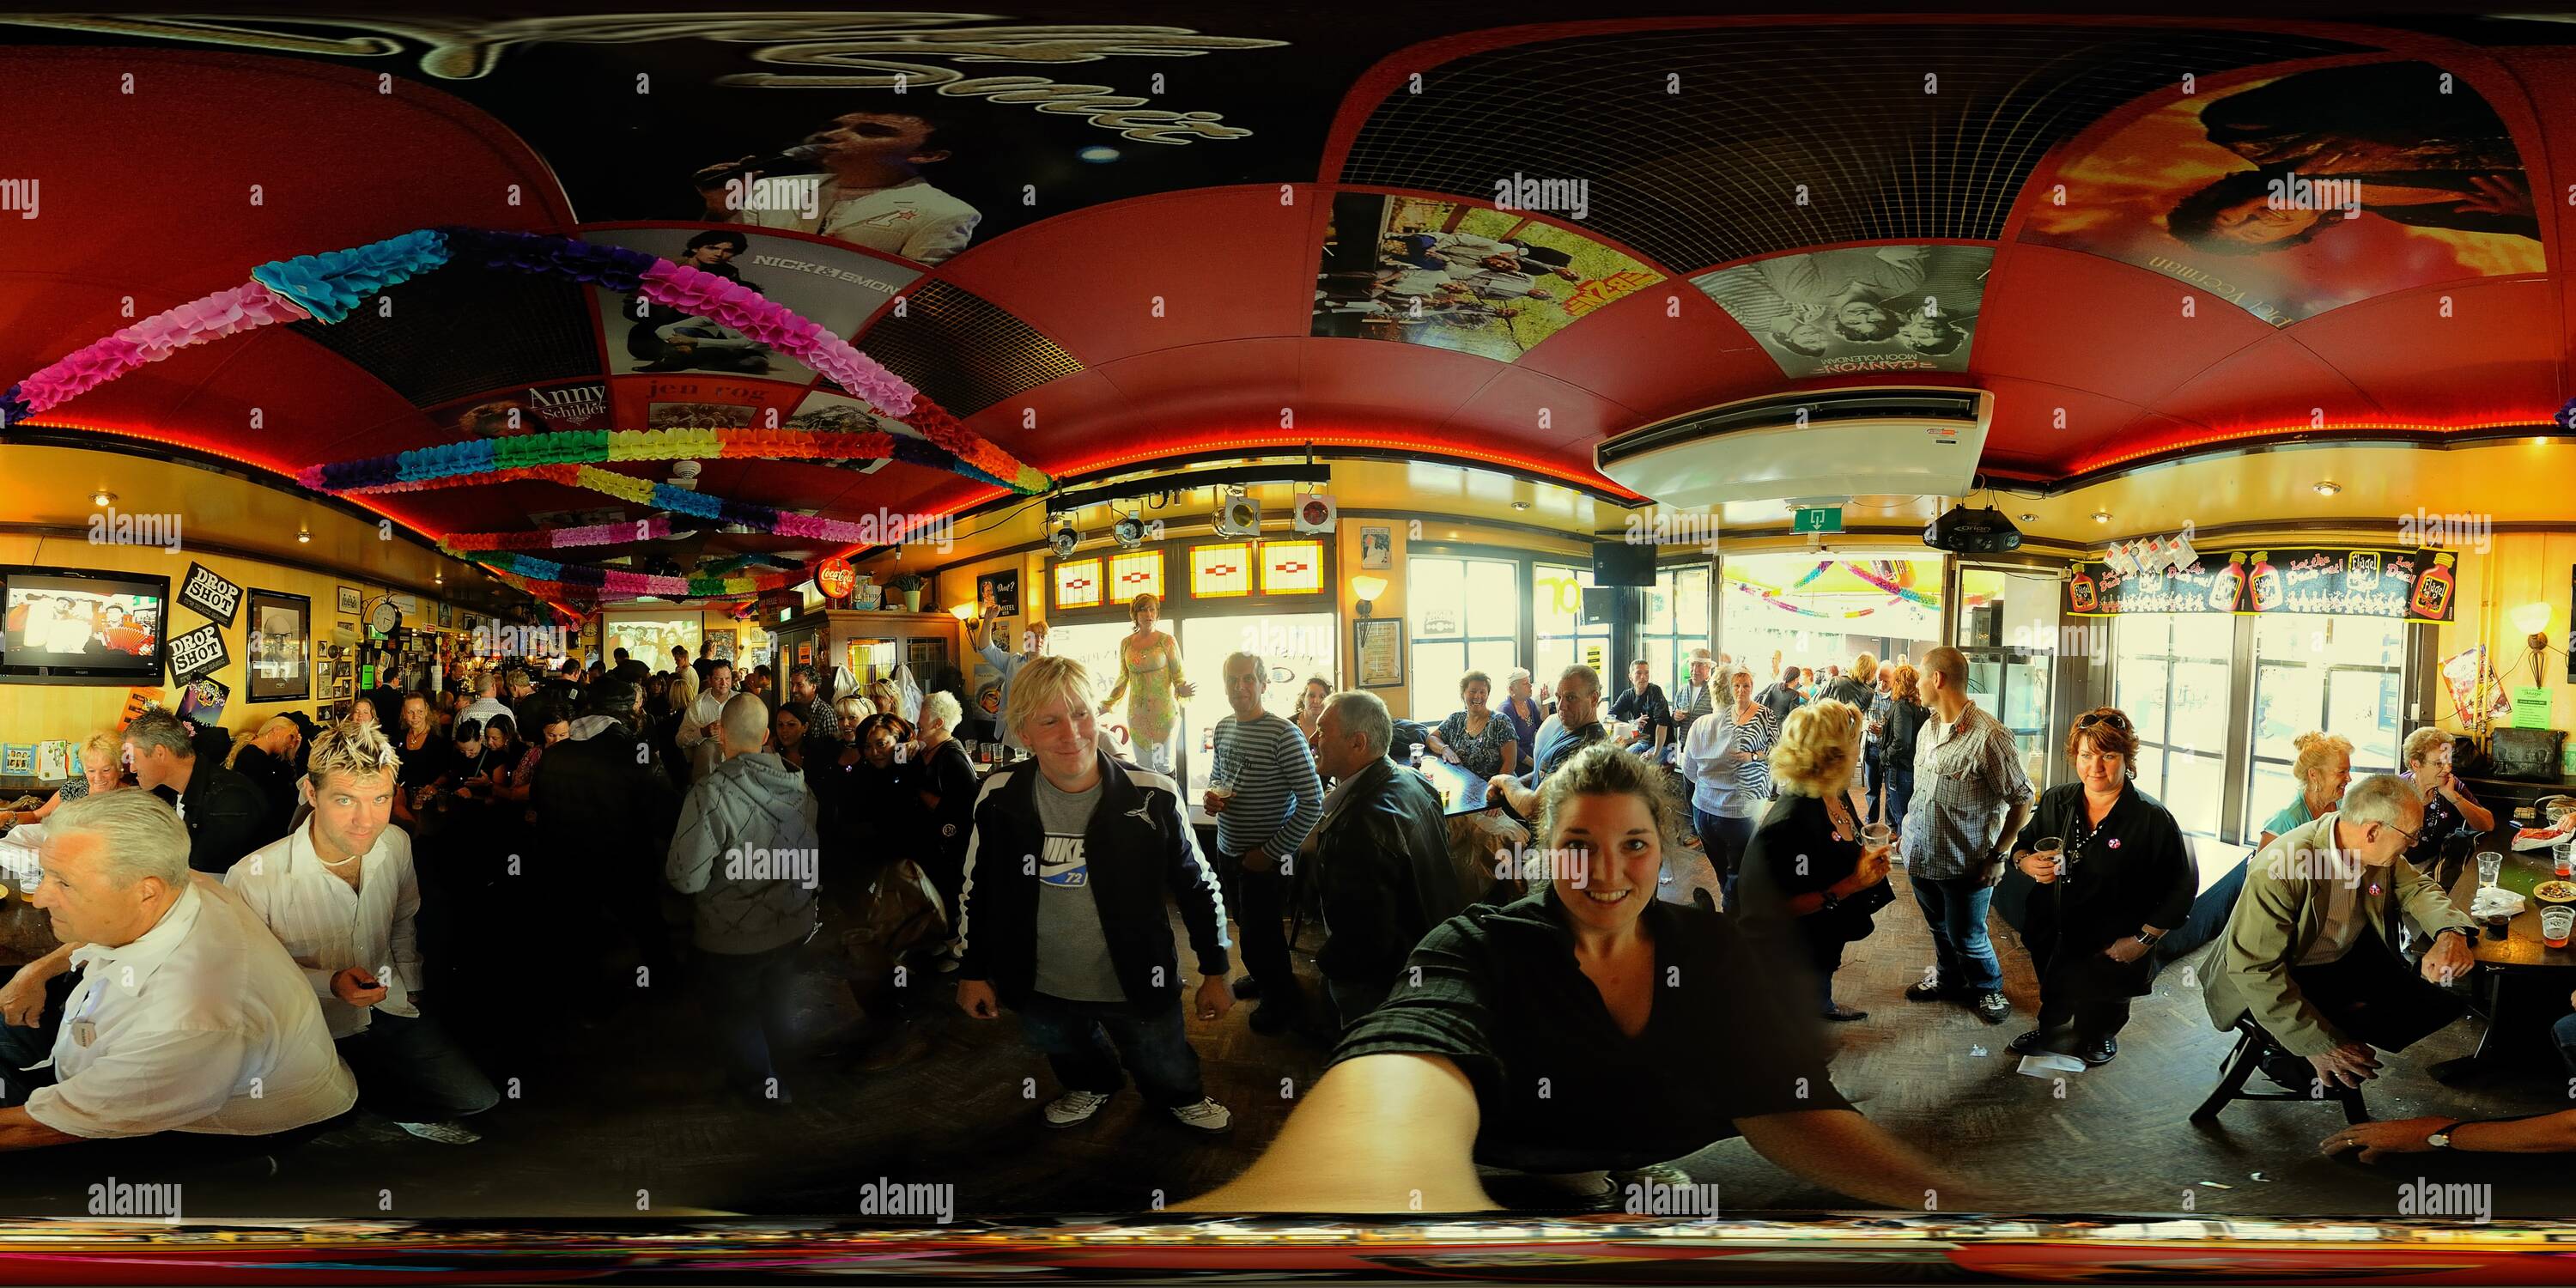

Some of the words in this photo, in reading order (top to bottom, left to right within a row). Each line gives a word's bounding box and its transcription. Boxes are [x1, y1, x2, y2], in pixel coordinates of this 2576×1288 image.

[715, 39, 1257, 146] Smit
[752, 255, 815, 273] NICK
[2148, 257, 2247, 303] Veerman
[1820, 354, 1882, 366] VOLENDAM
[529, 384, 605, 410] Anny
[543, 402, 606, 421] Schilder
[2351, 554, 2378, 573] Flügel
[189, 581, 233, 612] SHOT
[194, 567, 239, 601] DROP
[2423, 576, 2446, 599] Flügel
[169, 626, 216, 656] DROP
[175, 642, 218, 674] SHOT
[1042, 836, 1086, 863] NIKE
[1065, 872, 1083, 884] 72
